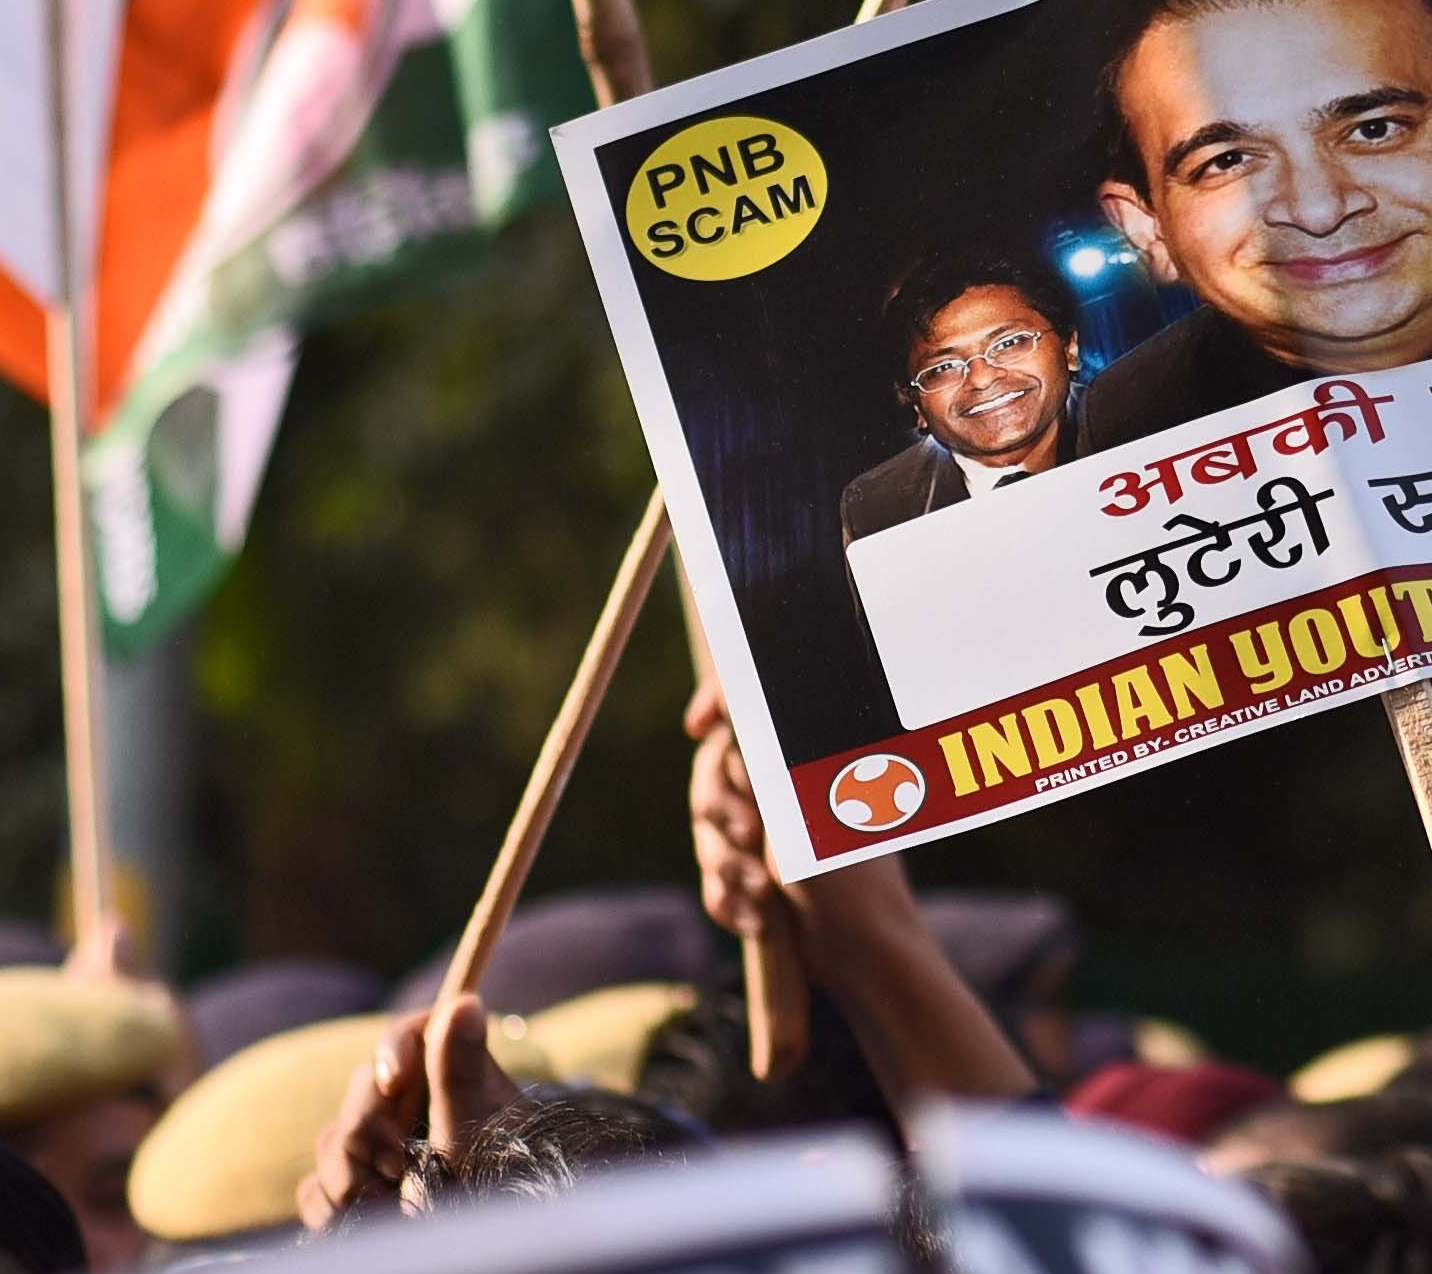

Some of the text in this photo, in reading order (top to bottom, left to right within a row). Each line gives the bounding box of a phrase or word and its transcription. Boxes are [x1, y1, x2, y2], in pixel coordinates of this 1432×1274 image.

[646, 133, 785, 209] PNB
[647, 174, 817, 259] SCAM
[1099, 379, 1394, 517] अबकी
[1089, 477, 1335, 638] लुटेरी
[938, 642, 1225, 798] INDIAN
[1035, 749, 1128, 793] PRINTED
[1133, 738, 1170, 759] BY-
[1175, 698, 1281, 744] CREATIVE
[1284, 679, 1344, 707] LAND
